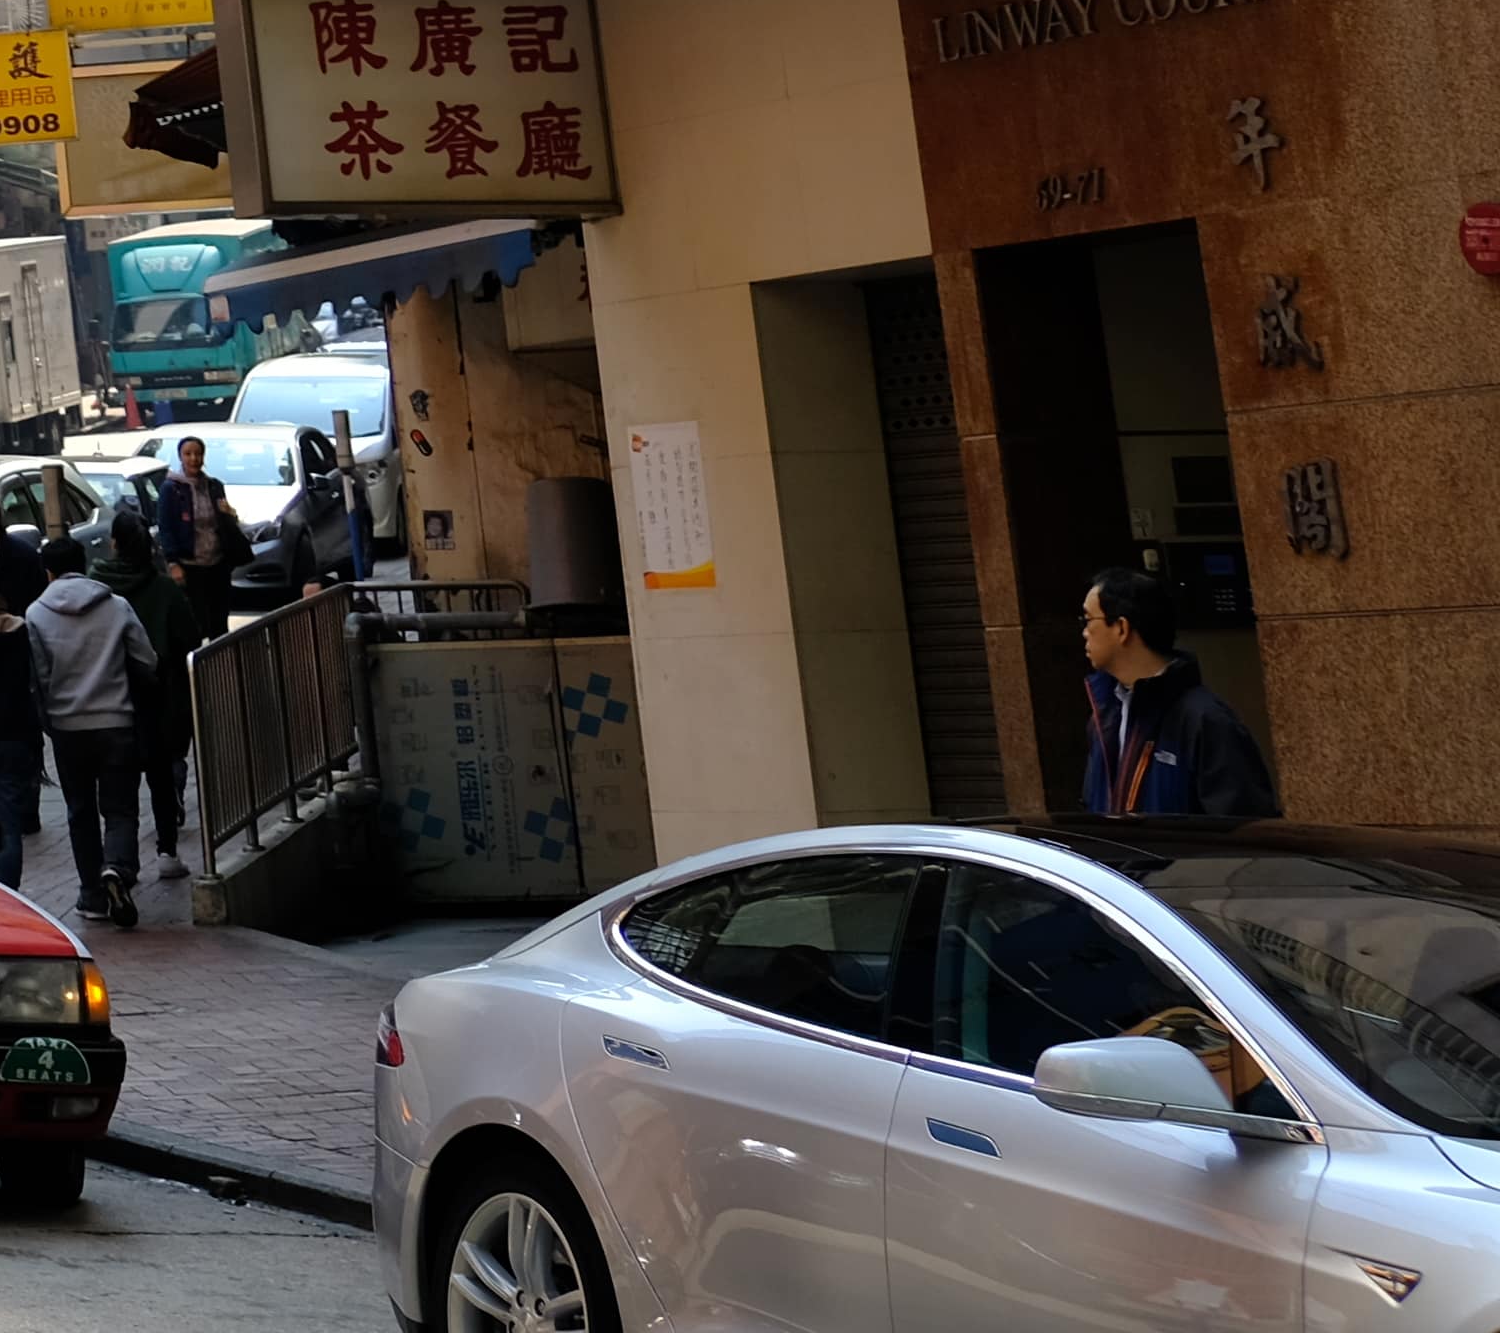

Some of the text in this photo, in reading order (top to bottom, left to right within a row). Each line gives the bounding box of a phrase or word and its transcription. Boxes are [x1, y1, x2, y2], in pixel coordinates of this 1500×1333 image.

[324, 100, 594, 181] 茶餐廳
[38, 1050, 54, 1070] 4
[15, 1068, 74, 1082] SEATS
